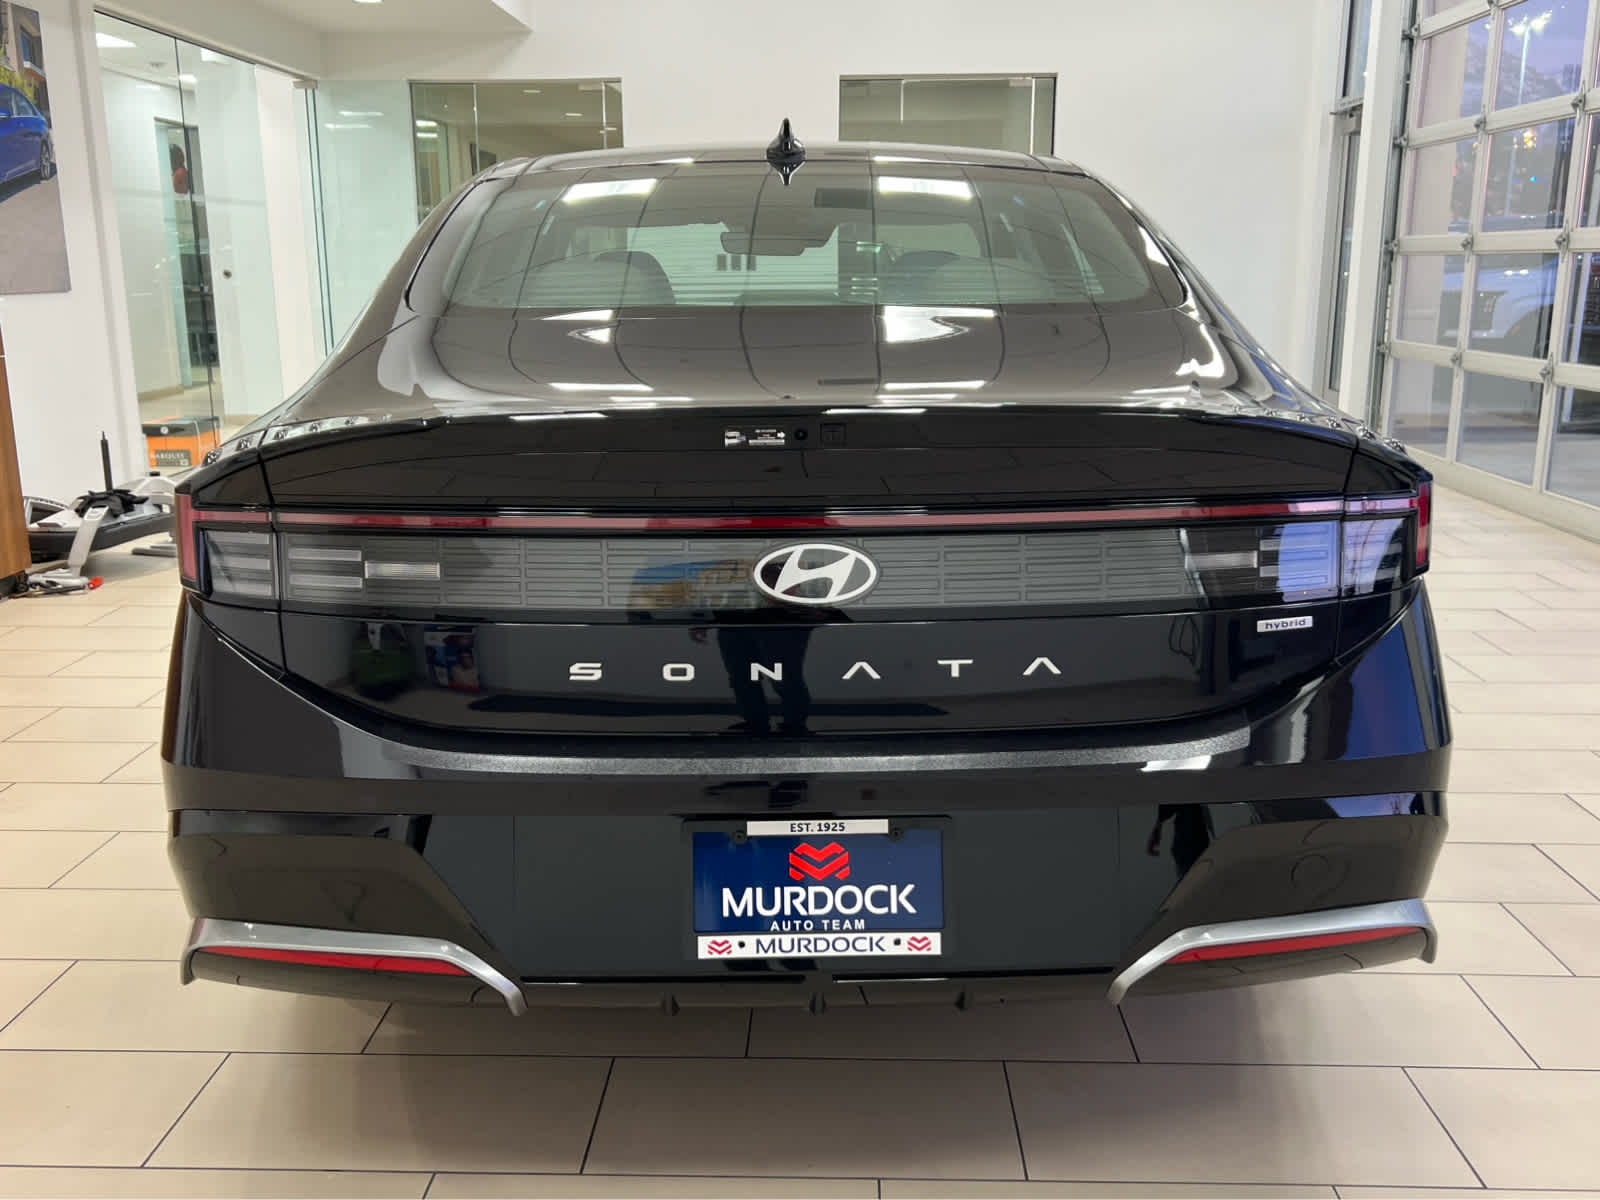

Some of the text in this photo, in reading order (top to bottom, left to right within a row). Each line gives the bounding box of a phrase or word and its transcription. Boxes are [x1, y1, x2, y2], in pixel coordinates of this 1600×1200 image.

[1264, 618, 1307, 630] hybrid
[568, 656, 1062, 681] SONATA
[789, 822, 846, 833] EST. 1925
[722, 884, 917, 918] MURDOCK
[770, 919, 866, 931] AUTO TEAM
[755, 936, 887, 954] MURDOCK
